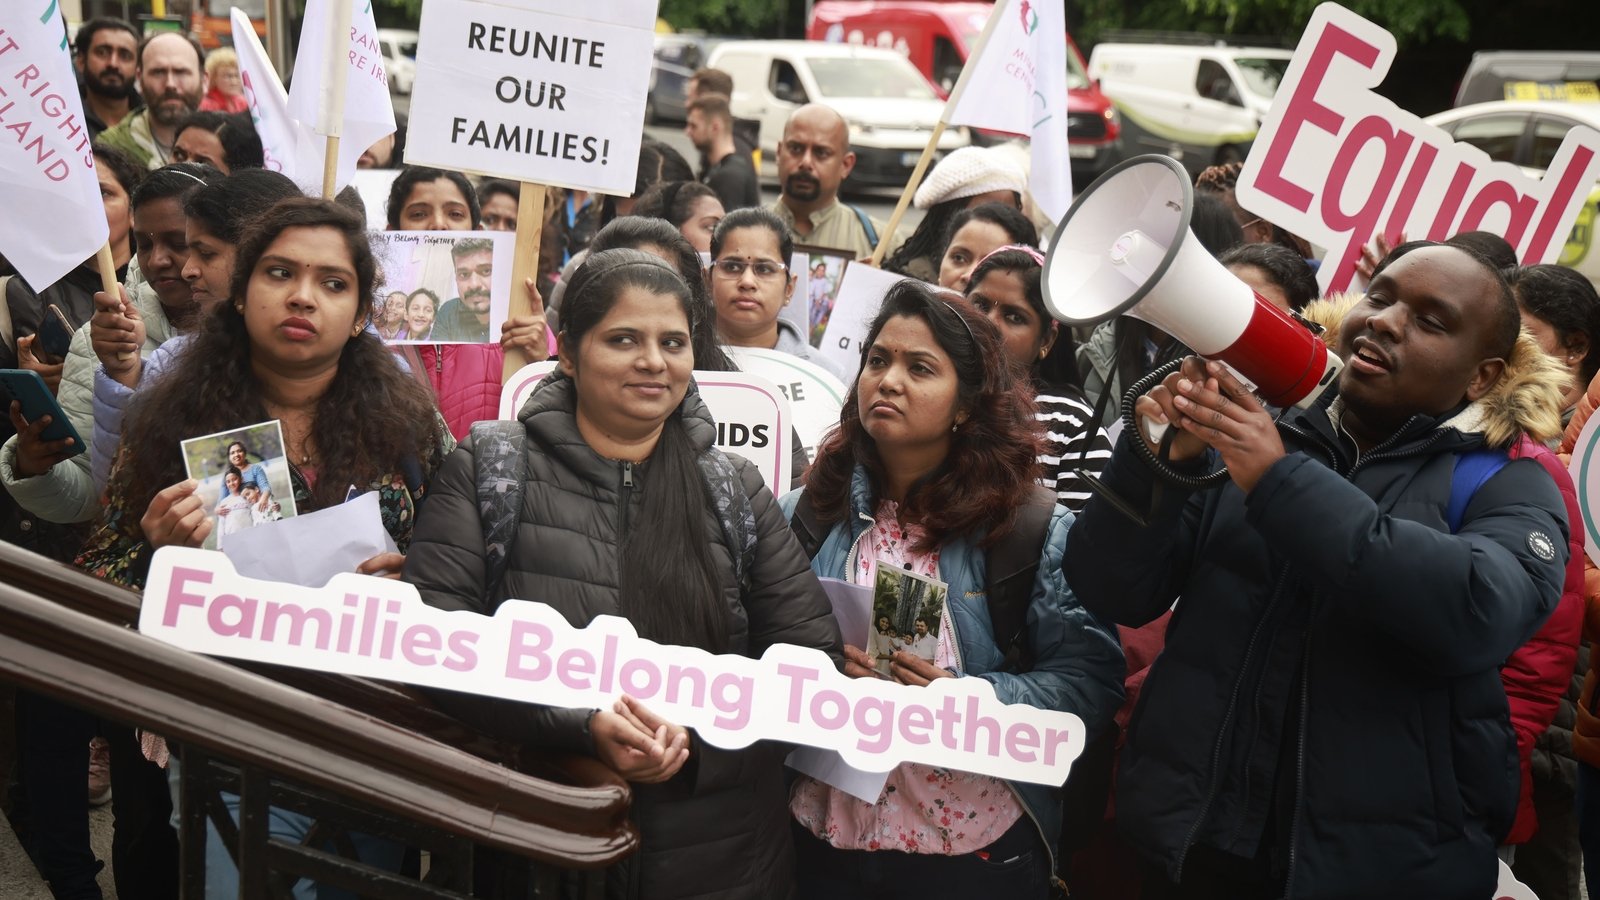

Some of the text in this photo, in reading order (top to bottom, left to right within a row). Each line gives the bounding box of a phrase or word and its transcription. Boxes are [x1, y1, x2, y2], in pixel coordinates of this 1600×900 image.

[468, 21, 605, 69] REUNITE
[0, 29, 94, 169] T RIGHTS
[495, 75, 567, 111] OUR
[0, 87, 70, 182] LAND
[451, 116, 610, 166] FAMILIES!
[1253, 21, 1595, 297] Equal
[838, 336, 851, 350] a
[713, 422, 769, 449] IDS
[162, 565, 1069, 767] Families Belong Together
